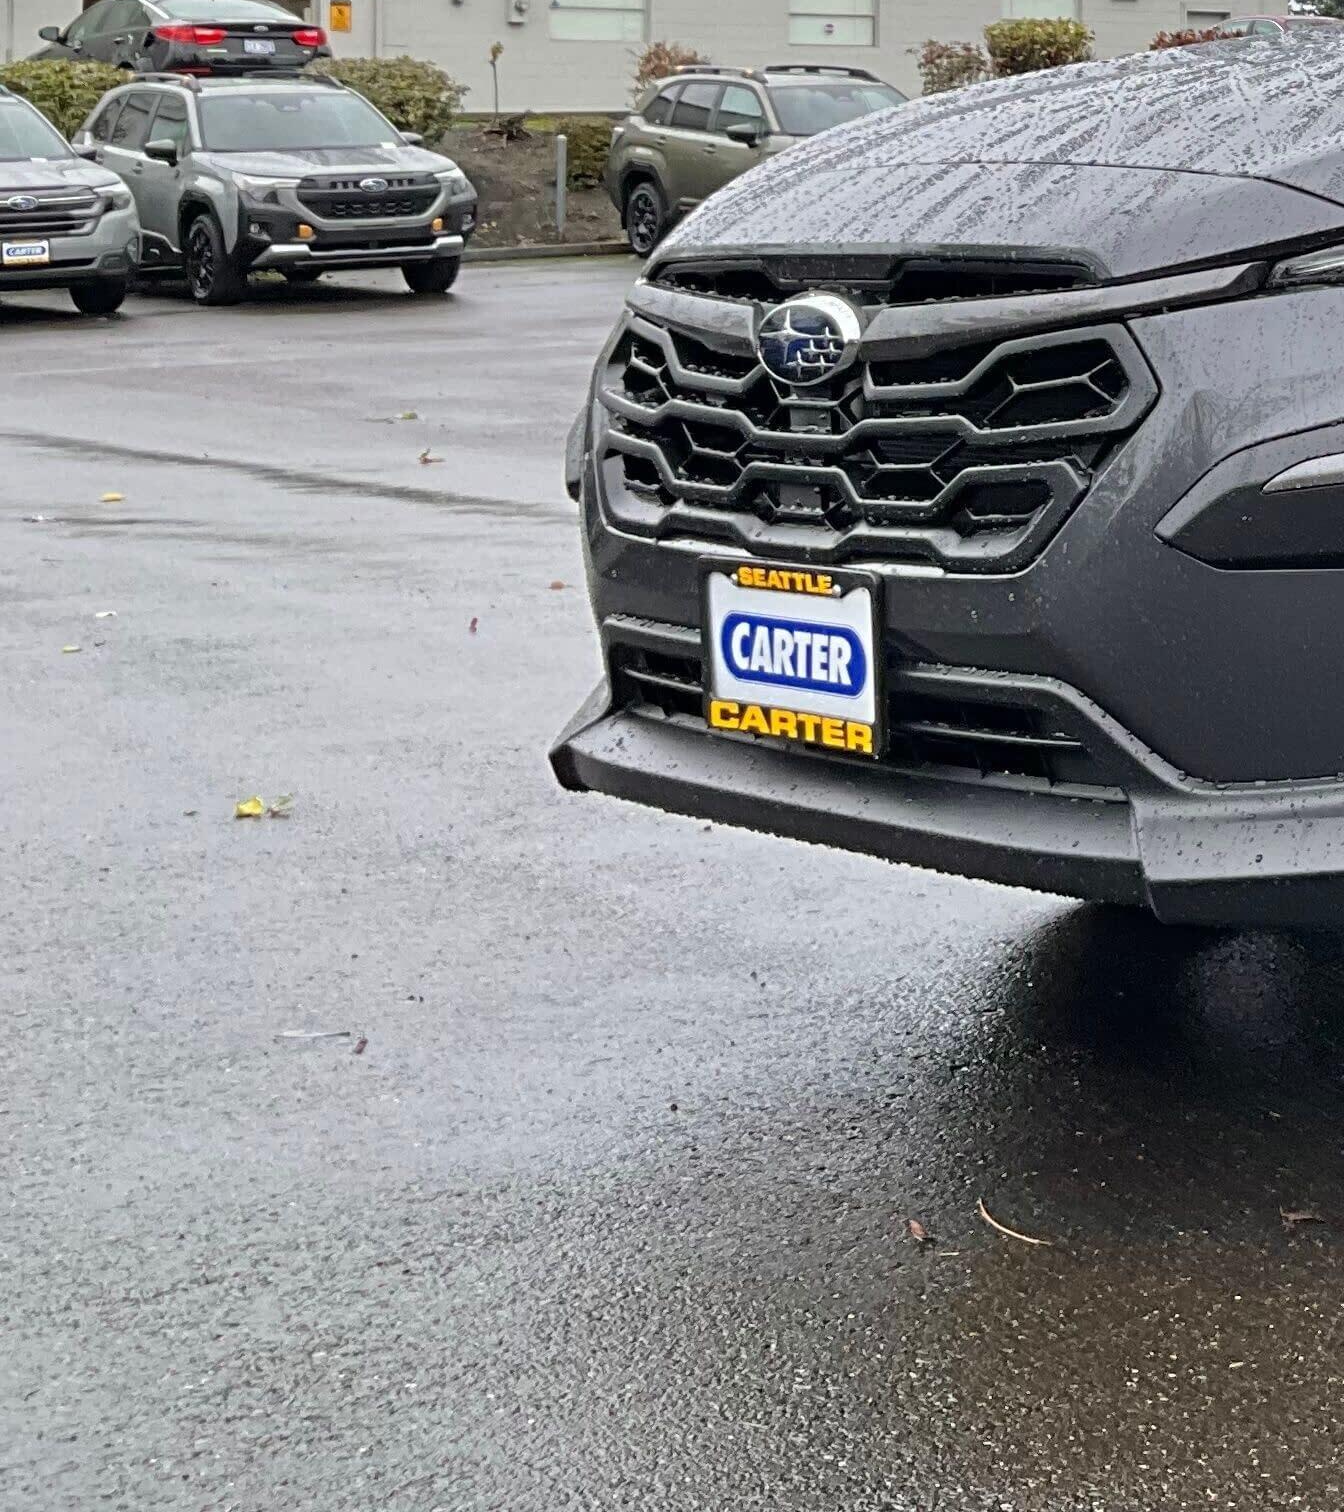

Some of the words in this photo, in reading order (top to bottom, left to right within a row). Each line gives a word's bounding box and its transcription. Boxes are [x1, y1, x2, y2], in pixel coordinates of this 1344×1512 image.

[738, 566, 832, 594] SEATTLE
[731, 622, 852, 685] CARTER
[710, 700, 873, 754] CARTER
